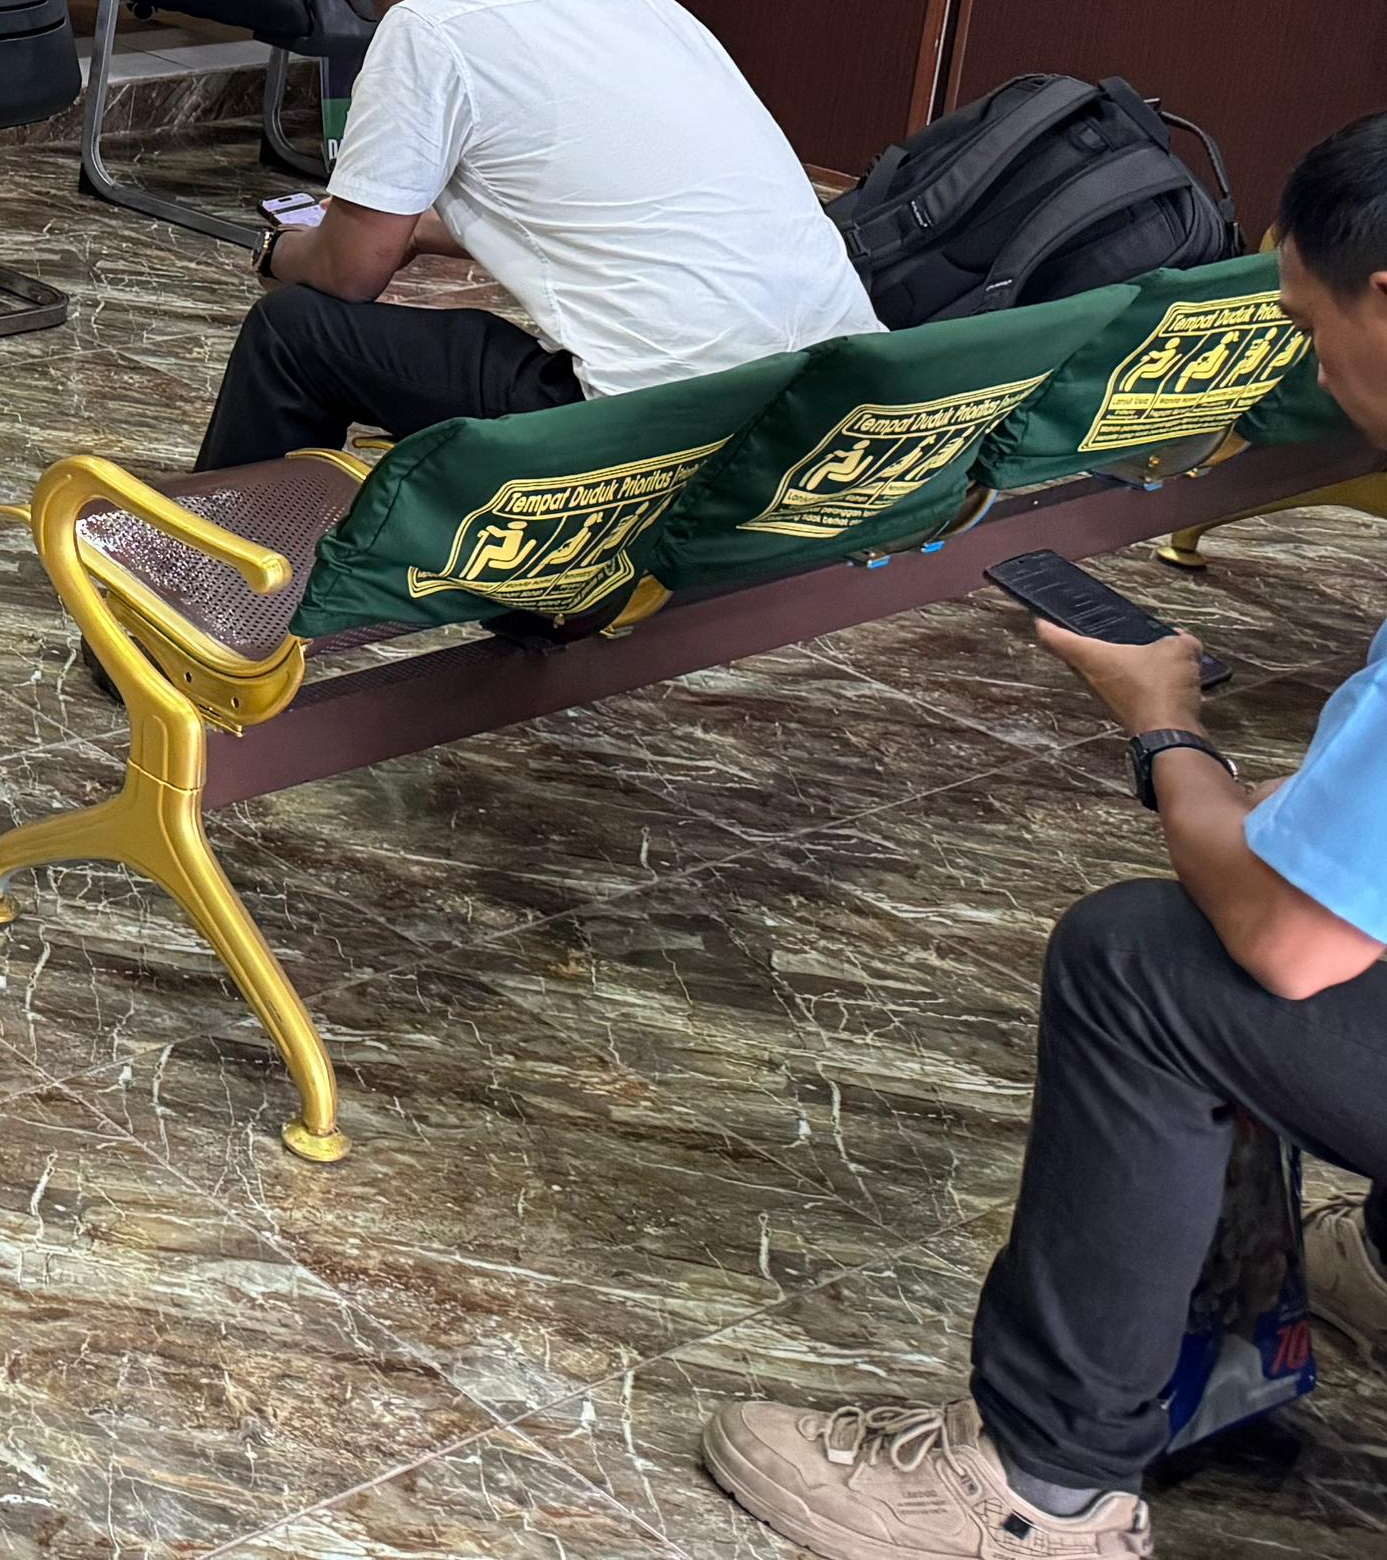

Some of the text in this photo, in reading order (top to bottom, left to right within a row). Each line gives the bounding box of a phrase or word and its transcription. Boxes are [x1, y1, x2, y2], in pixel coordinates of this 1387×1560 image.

[1168, 309, 1219, 333] Tempat
[1213, 306, 1255, 328] Duduk
[852, 412, 914, 435] Tempat
[913, 407, 956, 431] Duduk
[955, 398, 1002, 424] Prioritas
[506, 490, 569, 517] Tempat
[568, 478, 619, 508] Duduk
[620, 469, 672, 499] Prioritas
